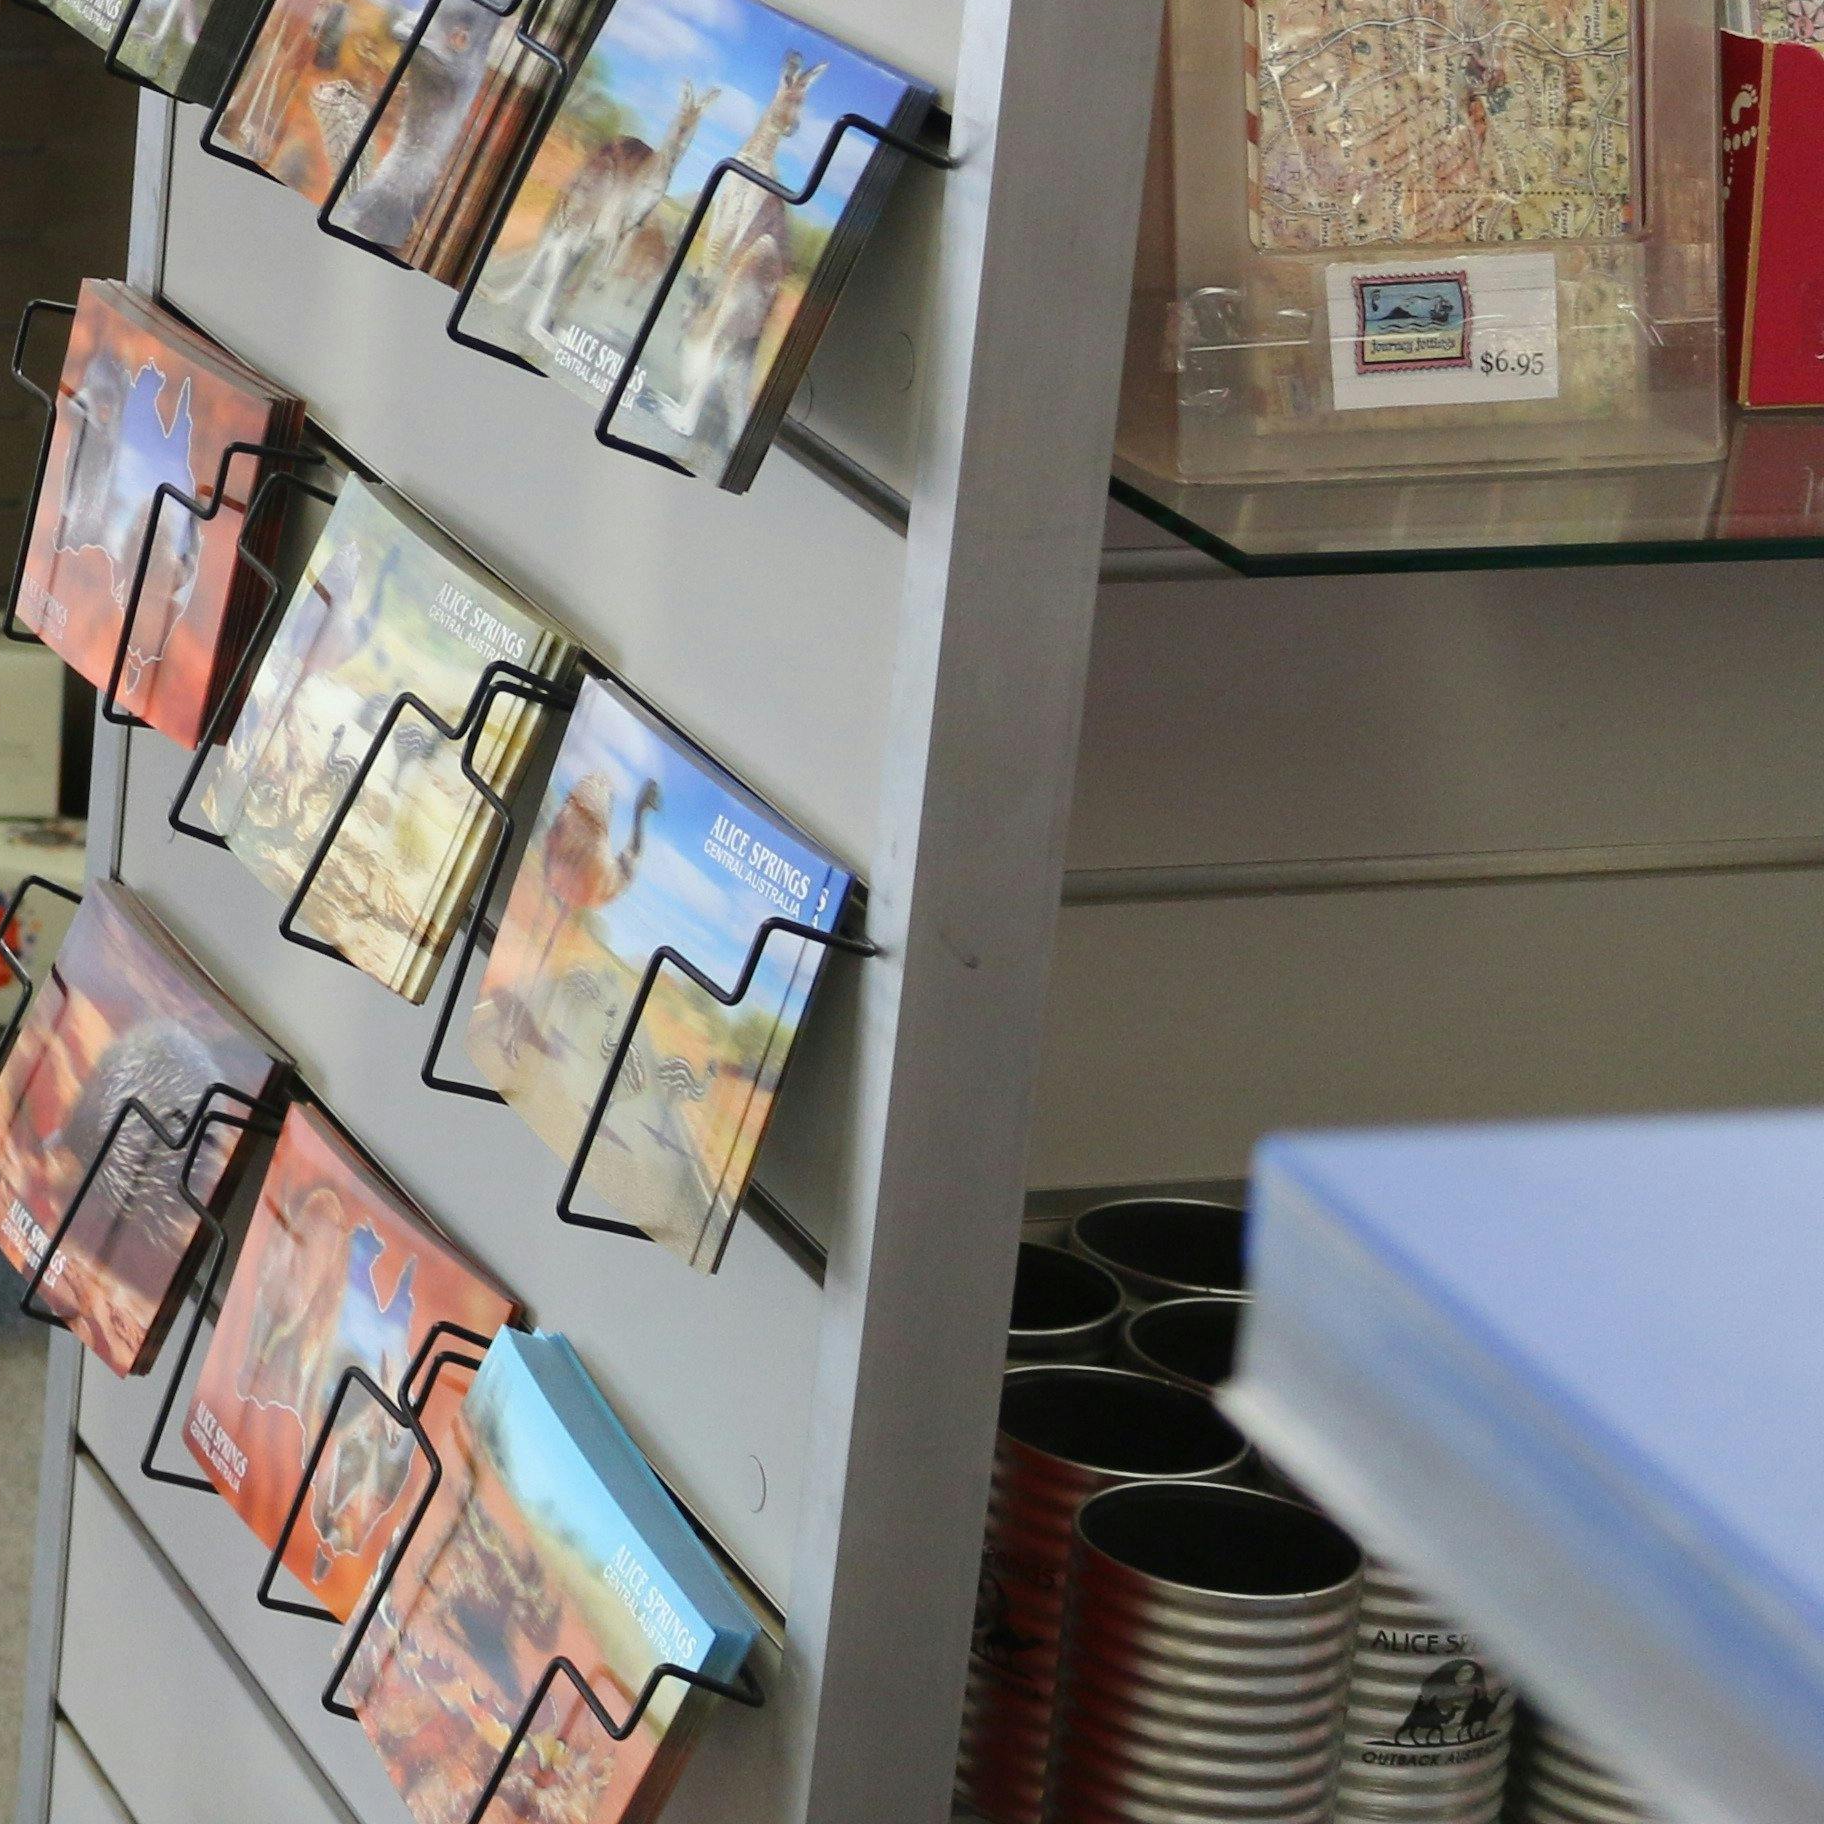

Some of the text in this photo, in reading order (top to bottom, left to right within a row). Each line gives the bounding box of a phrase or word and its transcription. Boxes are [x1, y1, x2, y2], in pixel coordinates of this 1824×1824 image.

[554, 348, 591, 383] CENTRAL
[560, 325, 599, 363] ALICE
[1479, 348, 1545, 376] $6.95
[428, 604, 466, 641] CENTRAL
[434, 582, 527, 659] ALICE SPRINGS
[703, 838, 746, 881] CENTRAL
[743, 869, 802, 919] AUSTRALIA
[709, 813, 812, 901] ALICE SPRINGS
[6, 1199, 34, 1237] ALICE
[189, 1419, 241, 1494] CENTRAL AUSTRALIA
[196, 1399, 249, 1478] ALICE SPRINGS
[602, 1563, 640, 1619] CENTRAL
[613, 1543, 699, 1661] ALICE SPRINGS
[1371, 1630, 1440, 1655] ALICE
[1361, 1751, 1441, 1767] OUTBACK
